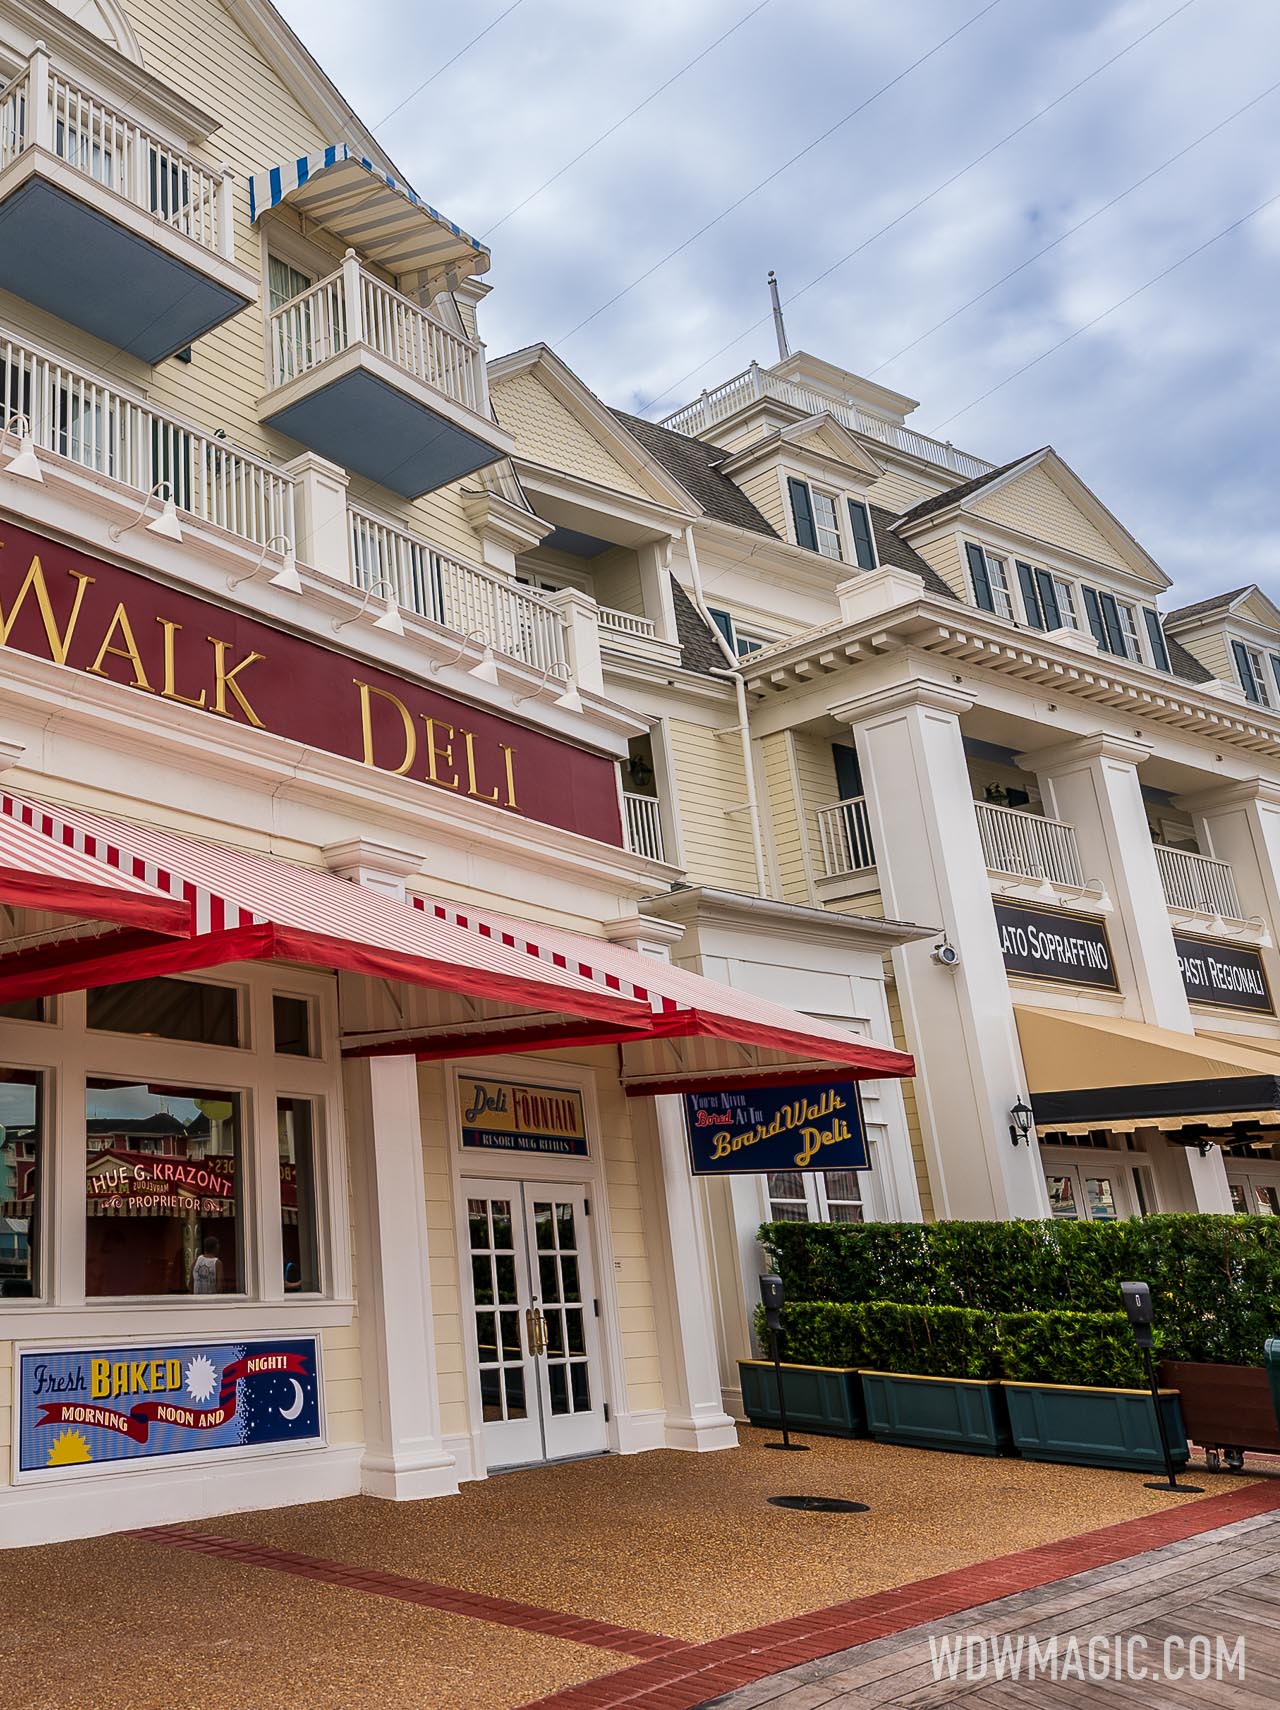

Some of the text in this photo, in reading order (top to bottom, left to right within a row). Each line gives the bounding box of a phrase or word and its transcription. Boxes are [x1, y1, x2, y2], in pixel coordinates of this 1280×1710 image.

[353, 678, 520, 811] DELI
[1027, 925, 1108, 970] SOPRAFFINO
[1208, 957, 1265, 996] REGIONALI
[465, 1085, 577, 1133] Deli FOUNTAIN
[695, 1109, 735, 1127] Bored
[710, 1089, 847, 1160] BoardWalk
[482, 1134, 515, 1147] RESORT
[518, 1137, 537, 1149] MUG
[794, 1118, 852, 1166] Deli
[92, 1166, 129, 1193] HUE
[134, 1164, 150, 1181] G.
[153, 1163, 232, 1197] KRAZONT
[128, 1195, 200, 1211] PROPRIETOR
[33, 1359, 183, 1400] Fresh BAKED
[247, 1356, 287, 1373] NIGHT!
[61, 1406, 225, 1432] MORNING NOON AND
